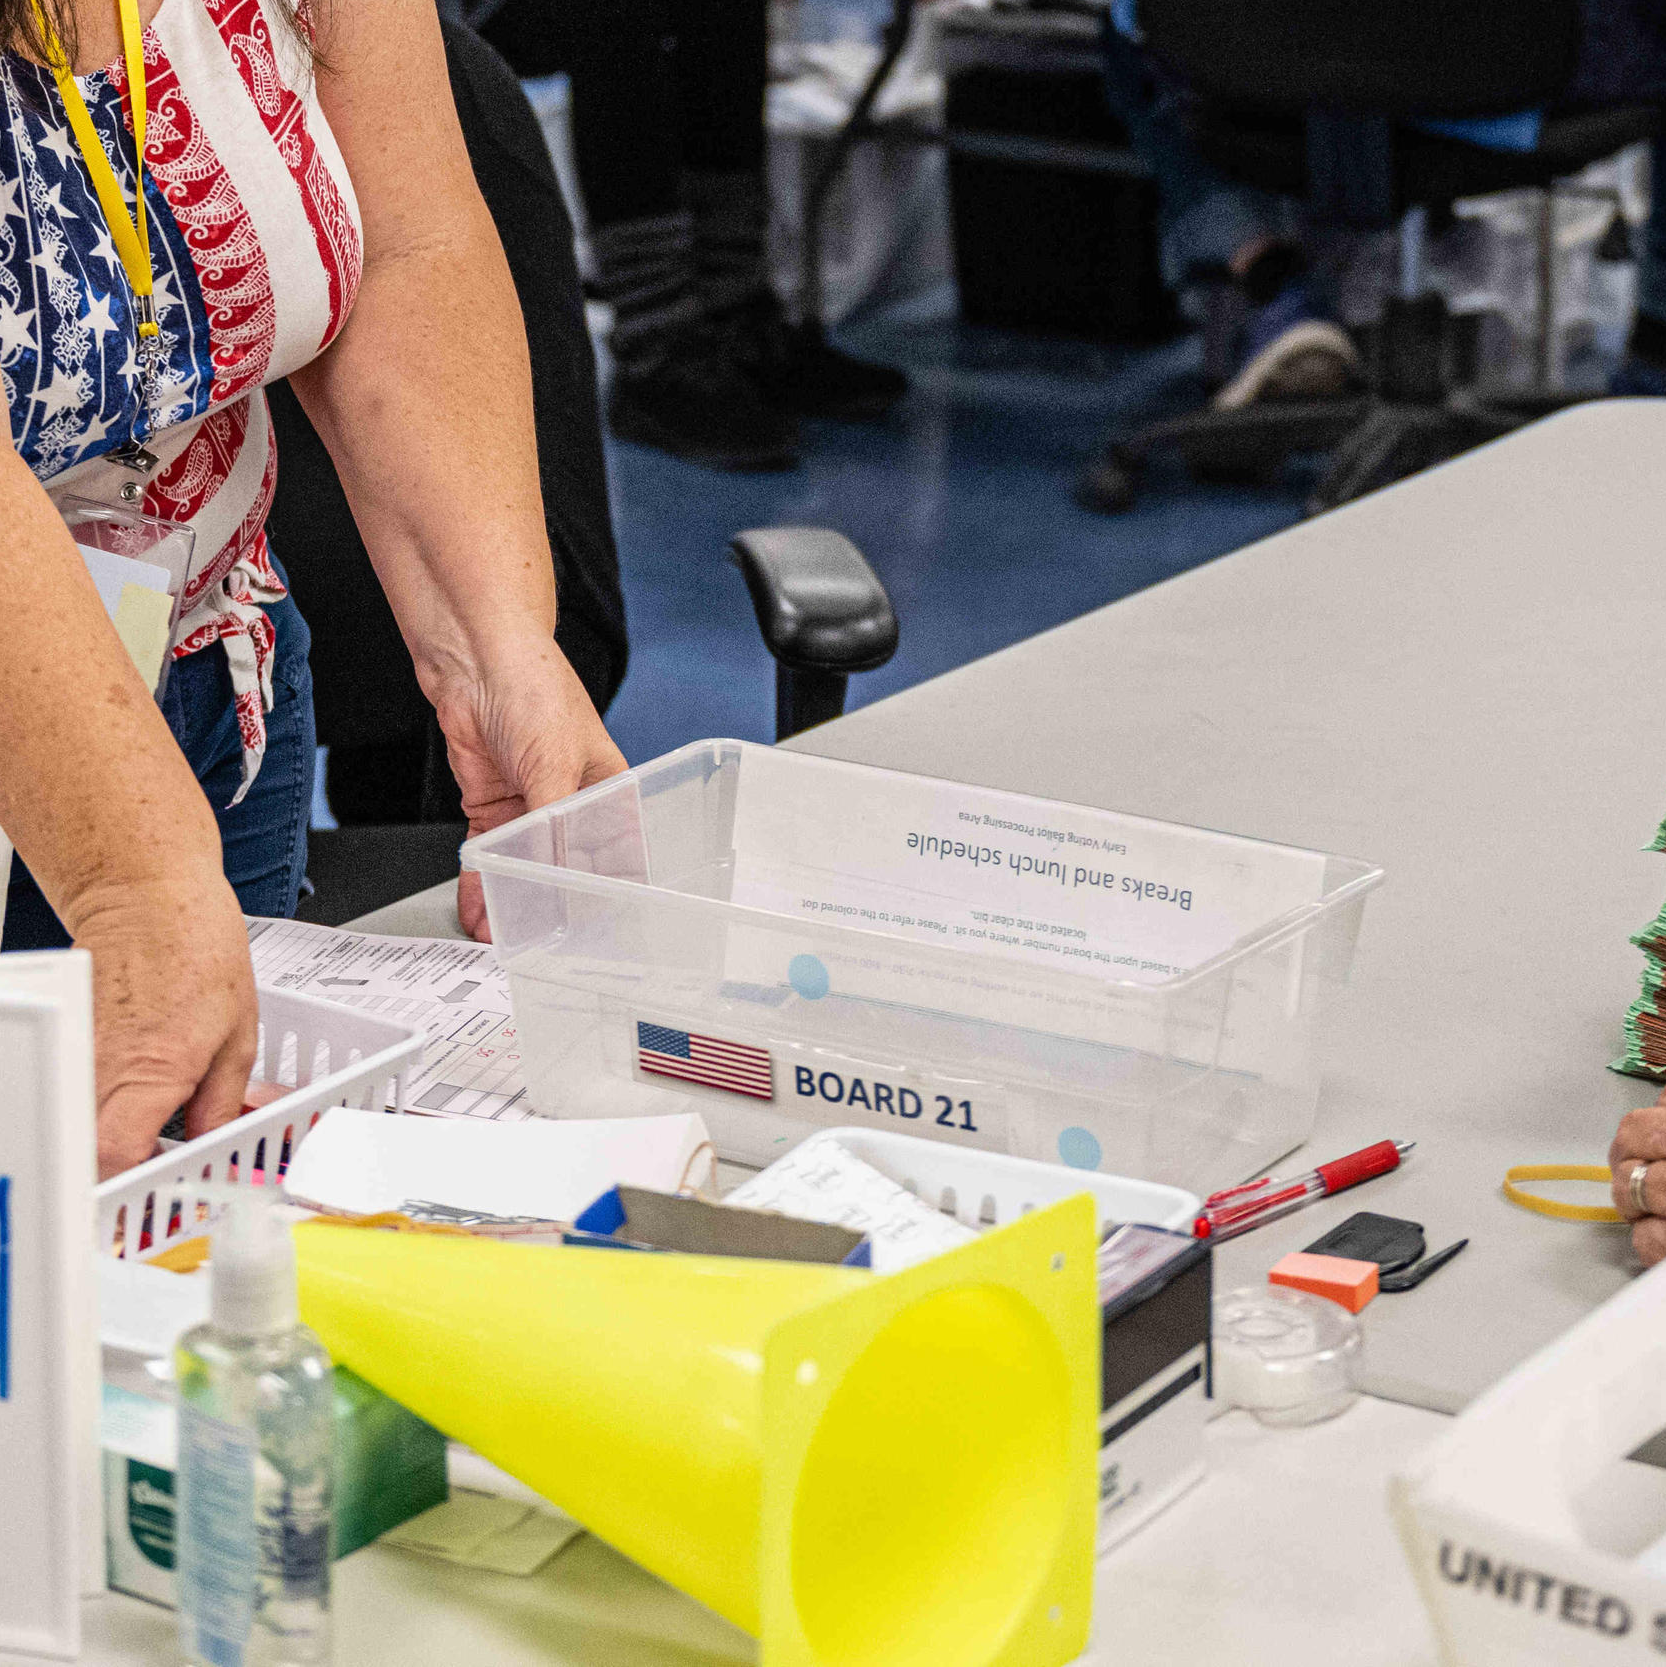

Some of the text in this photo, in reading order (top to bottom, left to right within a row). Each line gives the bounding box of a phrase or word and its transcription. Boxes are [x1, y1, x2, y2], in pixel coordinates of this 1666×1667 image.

[958, 811, 1127, 855] Early Voting Ballot Processing Area
[906, 832, 1193, 911] Breaks and lunch schedule
[801, 898, 819, 910] dot
[821, 901, 858, 916] colored
[860, 908, 876, 919] the
[878, 911, 890, 921] to
[890, 913, 915, 925] refer
[916, 916, 948, 932] Please
[952, 925, 967, 934] sit.
[970, 910, 1087, 941] located on the clear bin.
[968, 926, 987, 939] you
[989, 931, 1019, 945] where
[1020, 936, 1061, 954] number
[1064, 946, 1092, 959] board
[1094, 951, 1110, 962] the
[1111, 954, 1138, 969] upon
[1140, 960, 1170, 973] based
[795, 1065, 978, 1132] BOARD 21
[1438, 1537, 1631, 1638] UNITED
